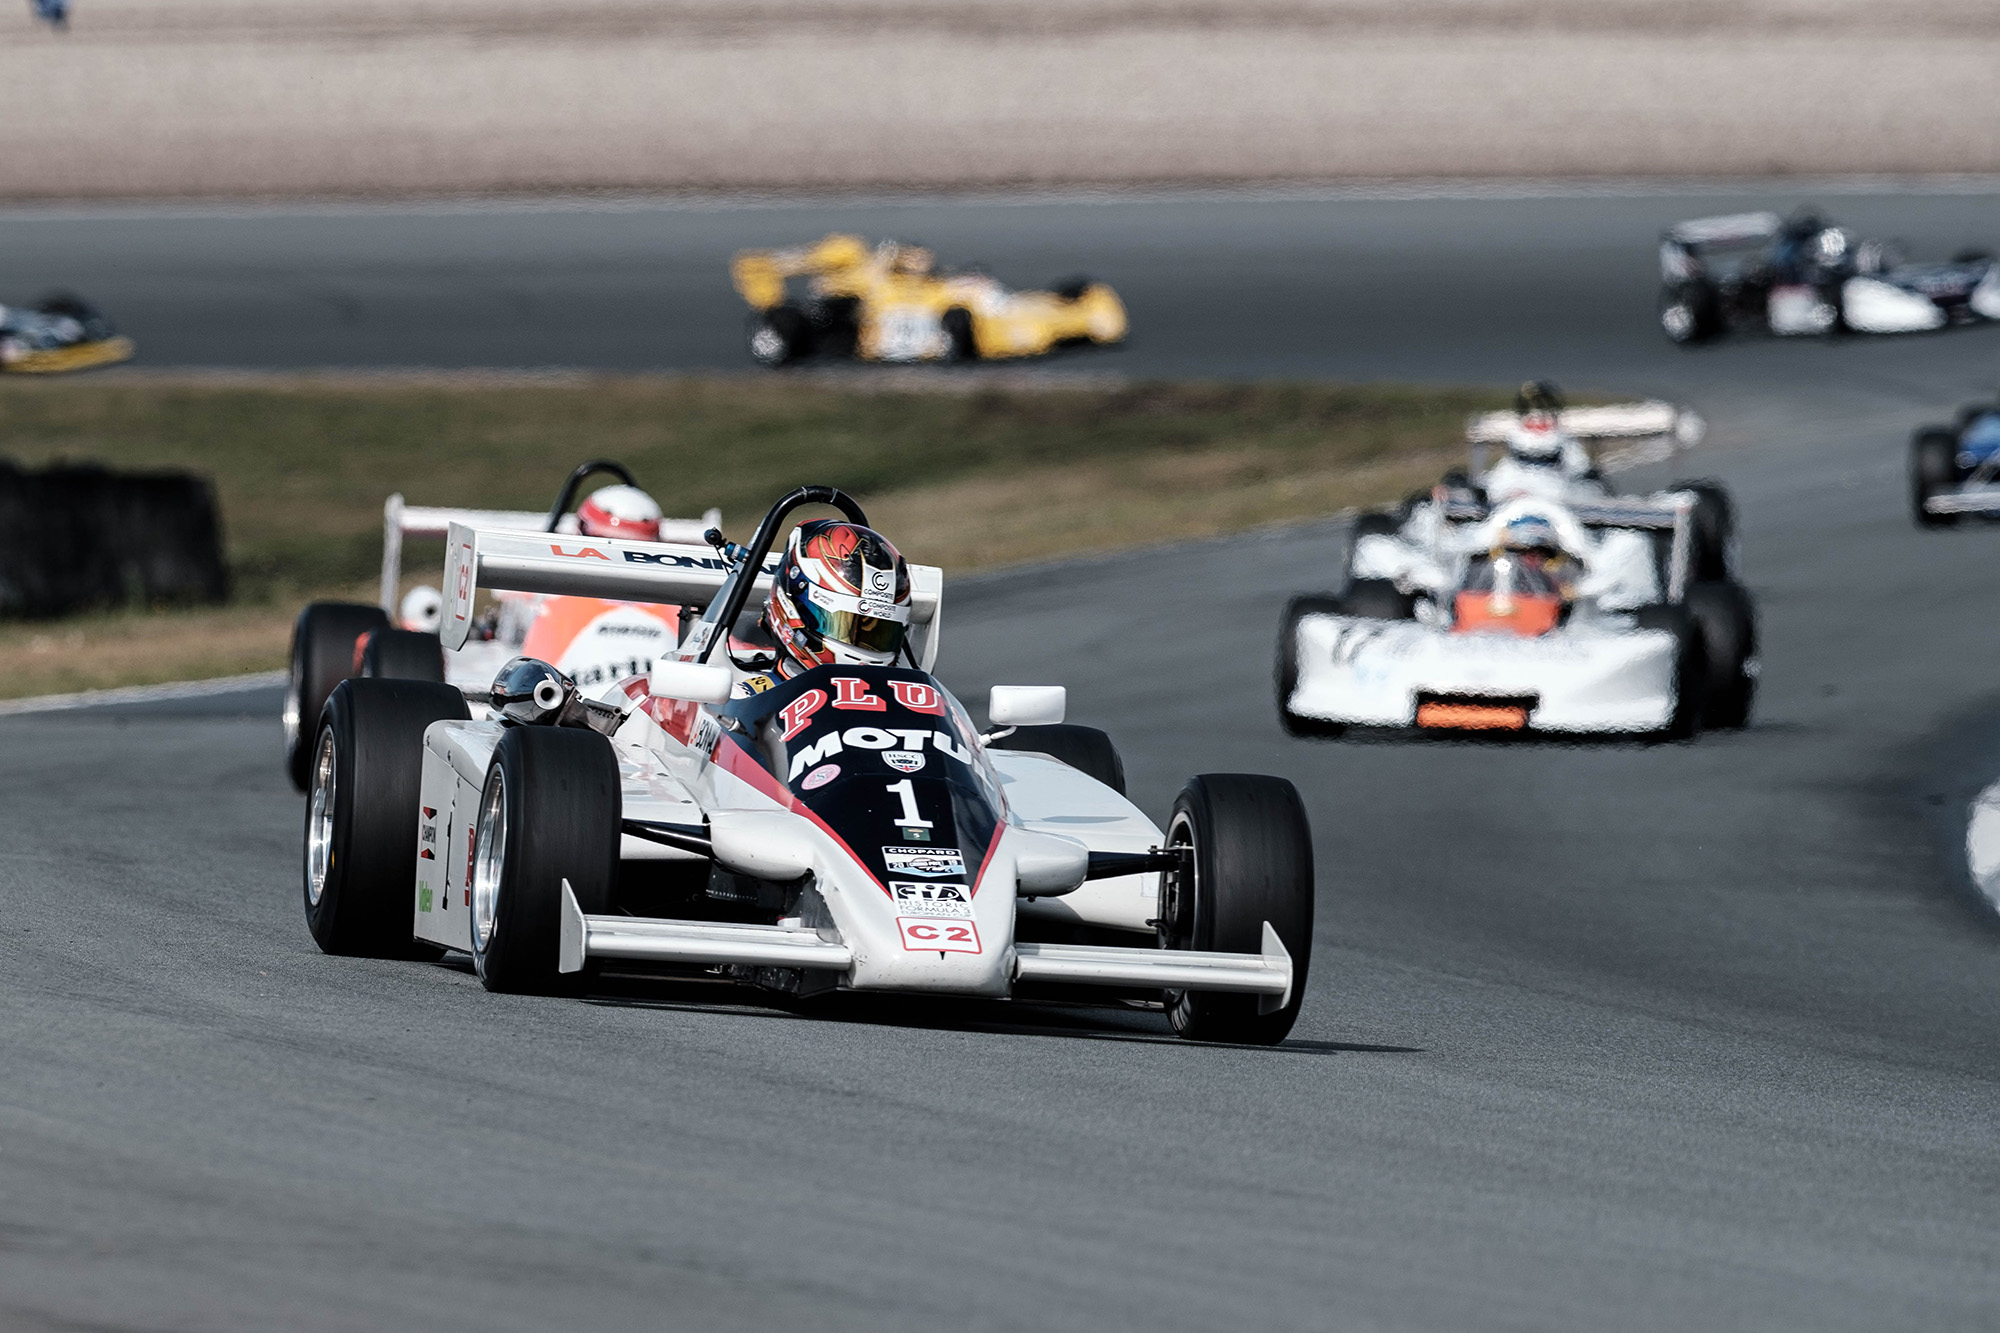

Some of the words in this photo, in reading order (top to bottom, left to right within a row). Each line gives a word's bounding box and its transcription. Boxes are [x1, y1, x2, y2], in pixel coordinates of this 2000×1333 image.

[550, 544, 611, 561] LA
[863, 588, 894, 599] COMPOSITE
[868, 601, 897, 612] COMPOSITE
[886, 779, 934, 828] 1
[898, 900, 970, 910] HISTORIC
[900, 905, 961, 914] FORMULA
[907, 925, 972, 942] C2
